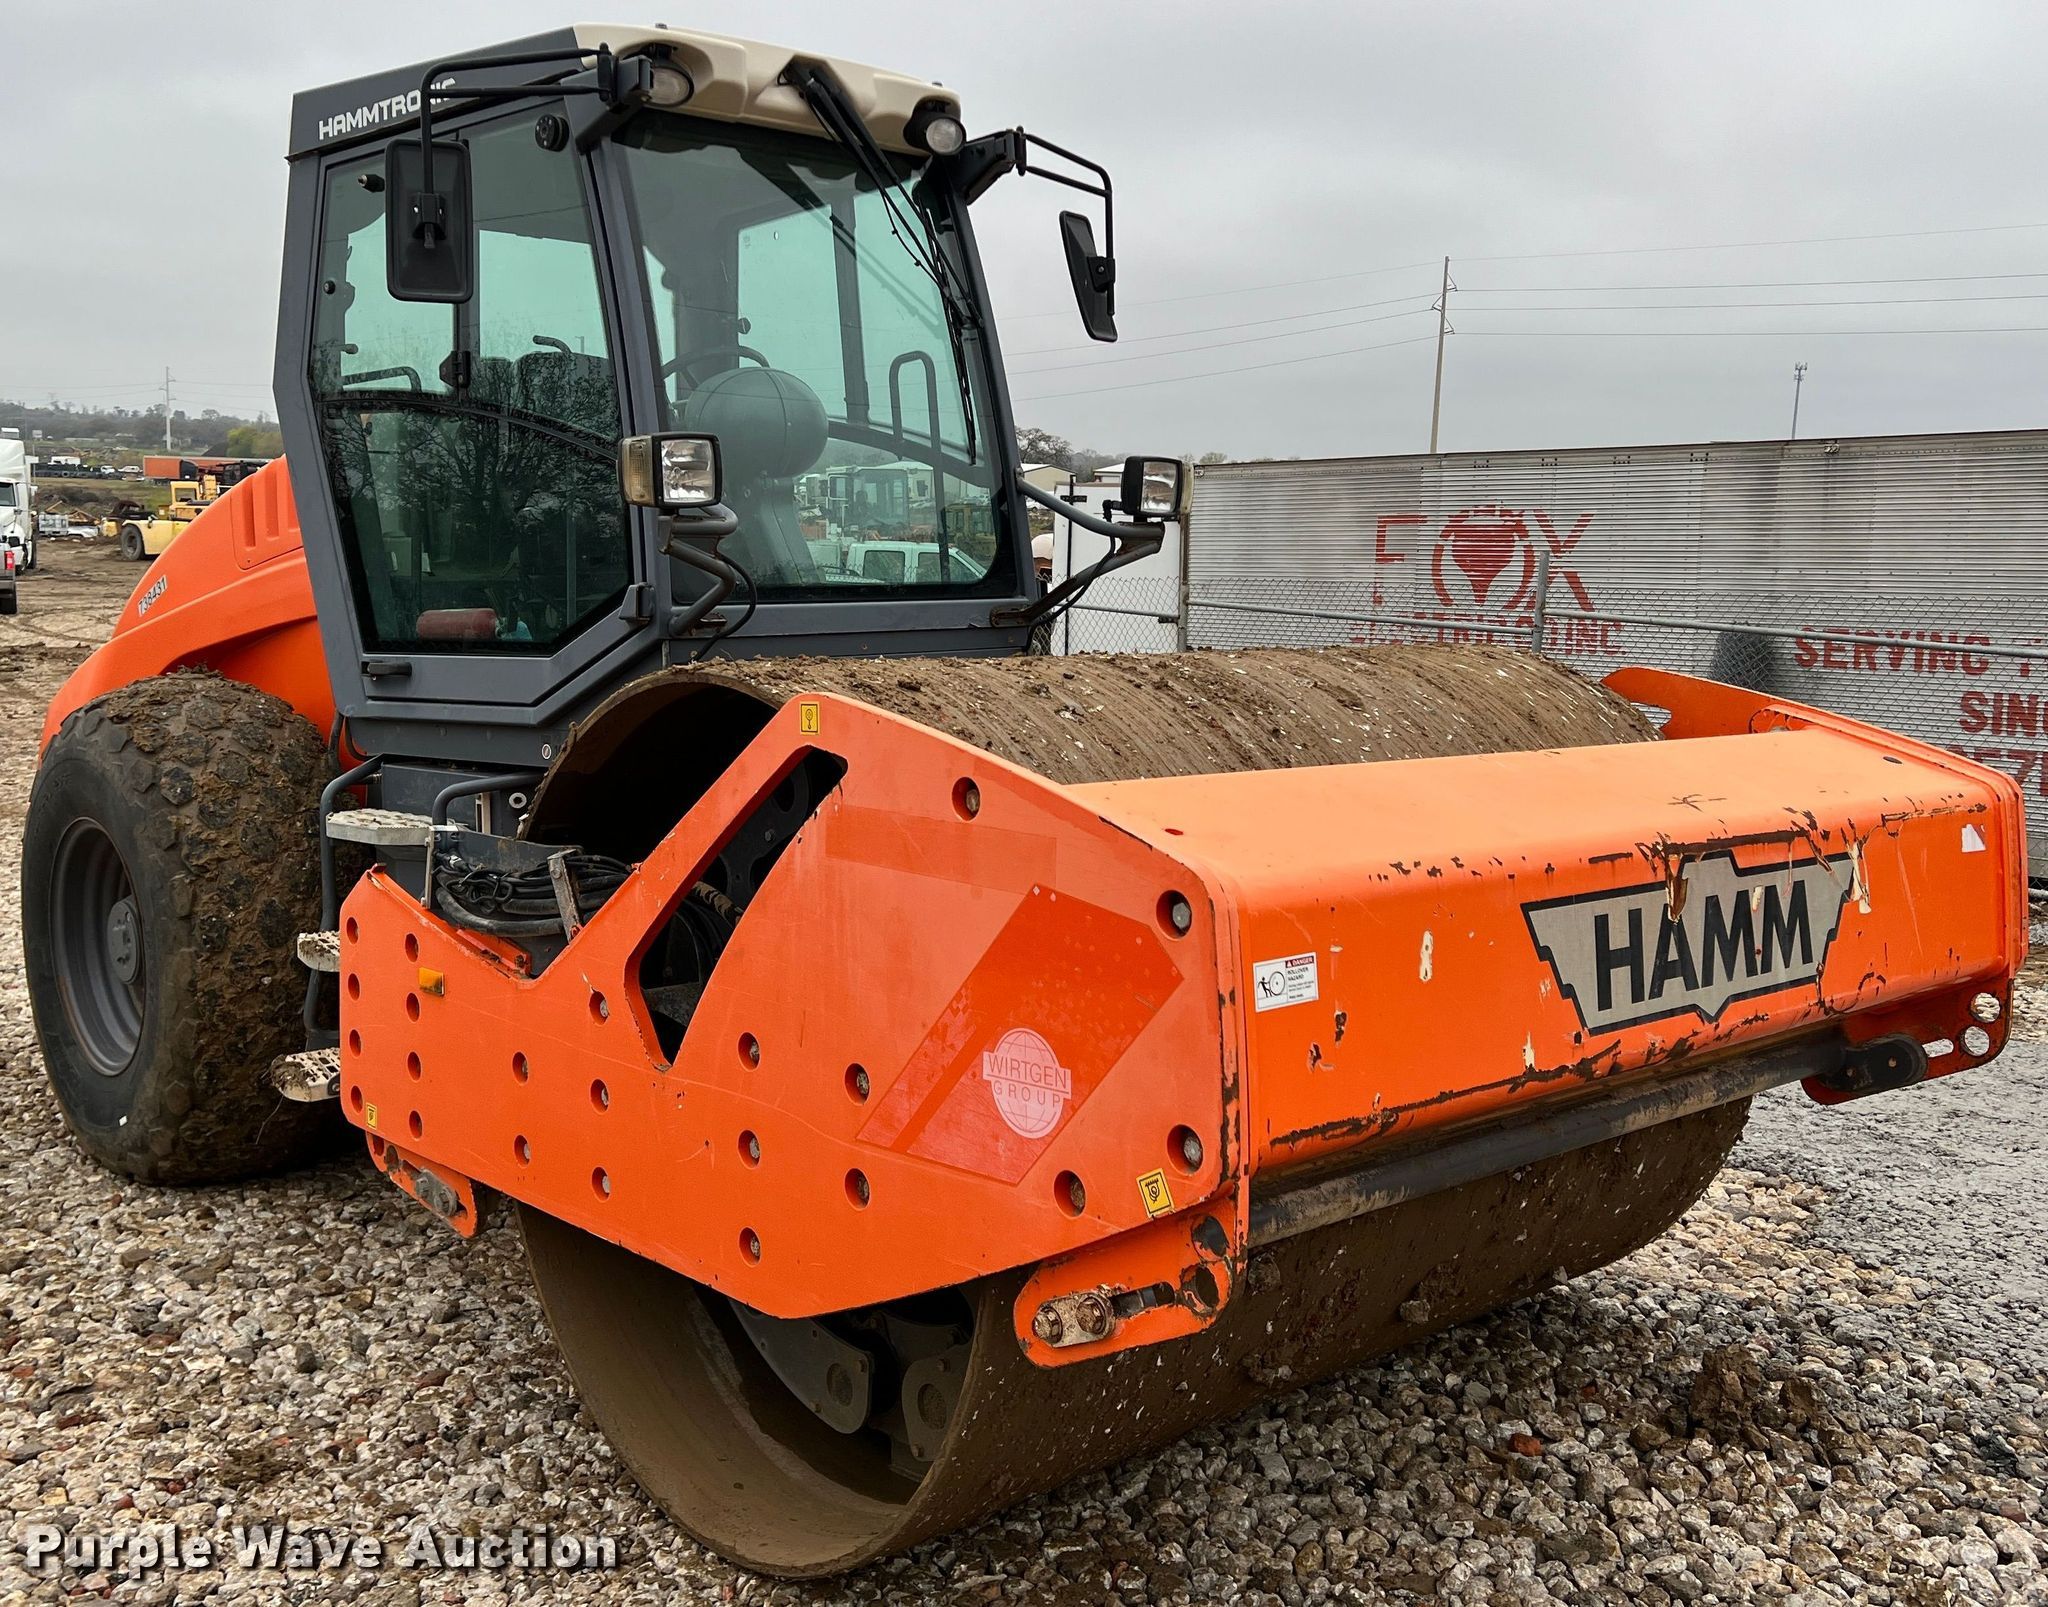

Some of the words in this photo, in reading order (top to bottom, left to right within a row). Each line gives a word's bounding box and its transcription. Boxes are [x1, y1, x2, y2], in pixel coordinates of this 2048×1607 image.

[1794, 625, 1990, 675] SERVING
[1959, 690, 2048, 737] SIN
[1593, 879, 1813, 1012] HAMM
[988, 1053, 1067, 1090] WIRTGEN
[993, 1080, 1061, 1108] GROUP
